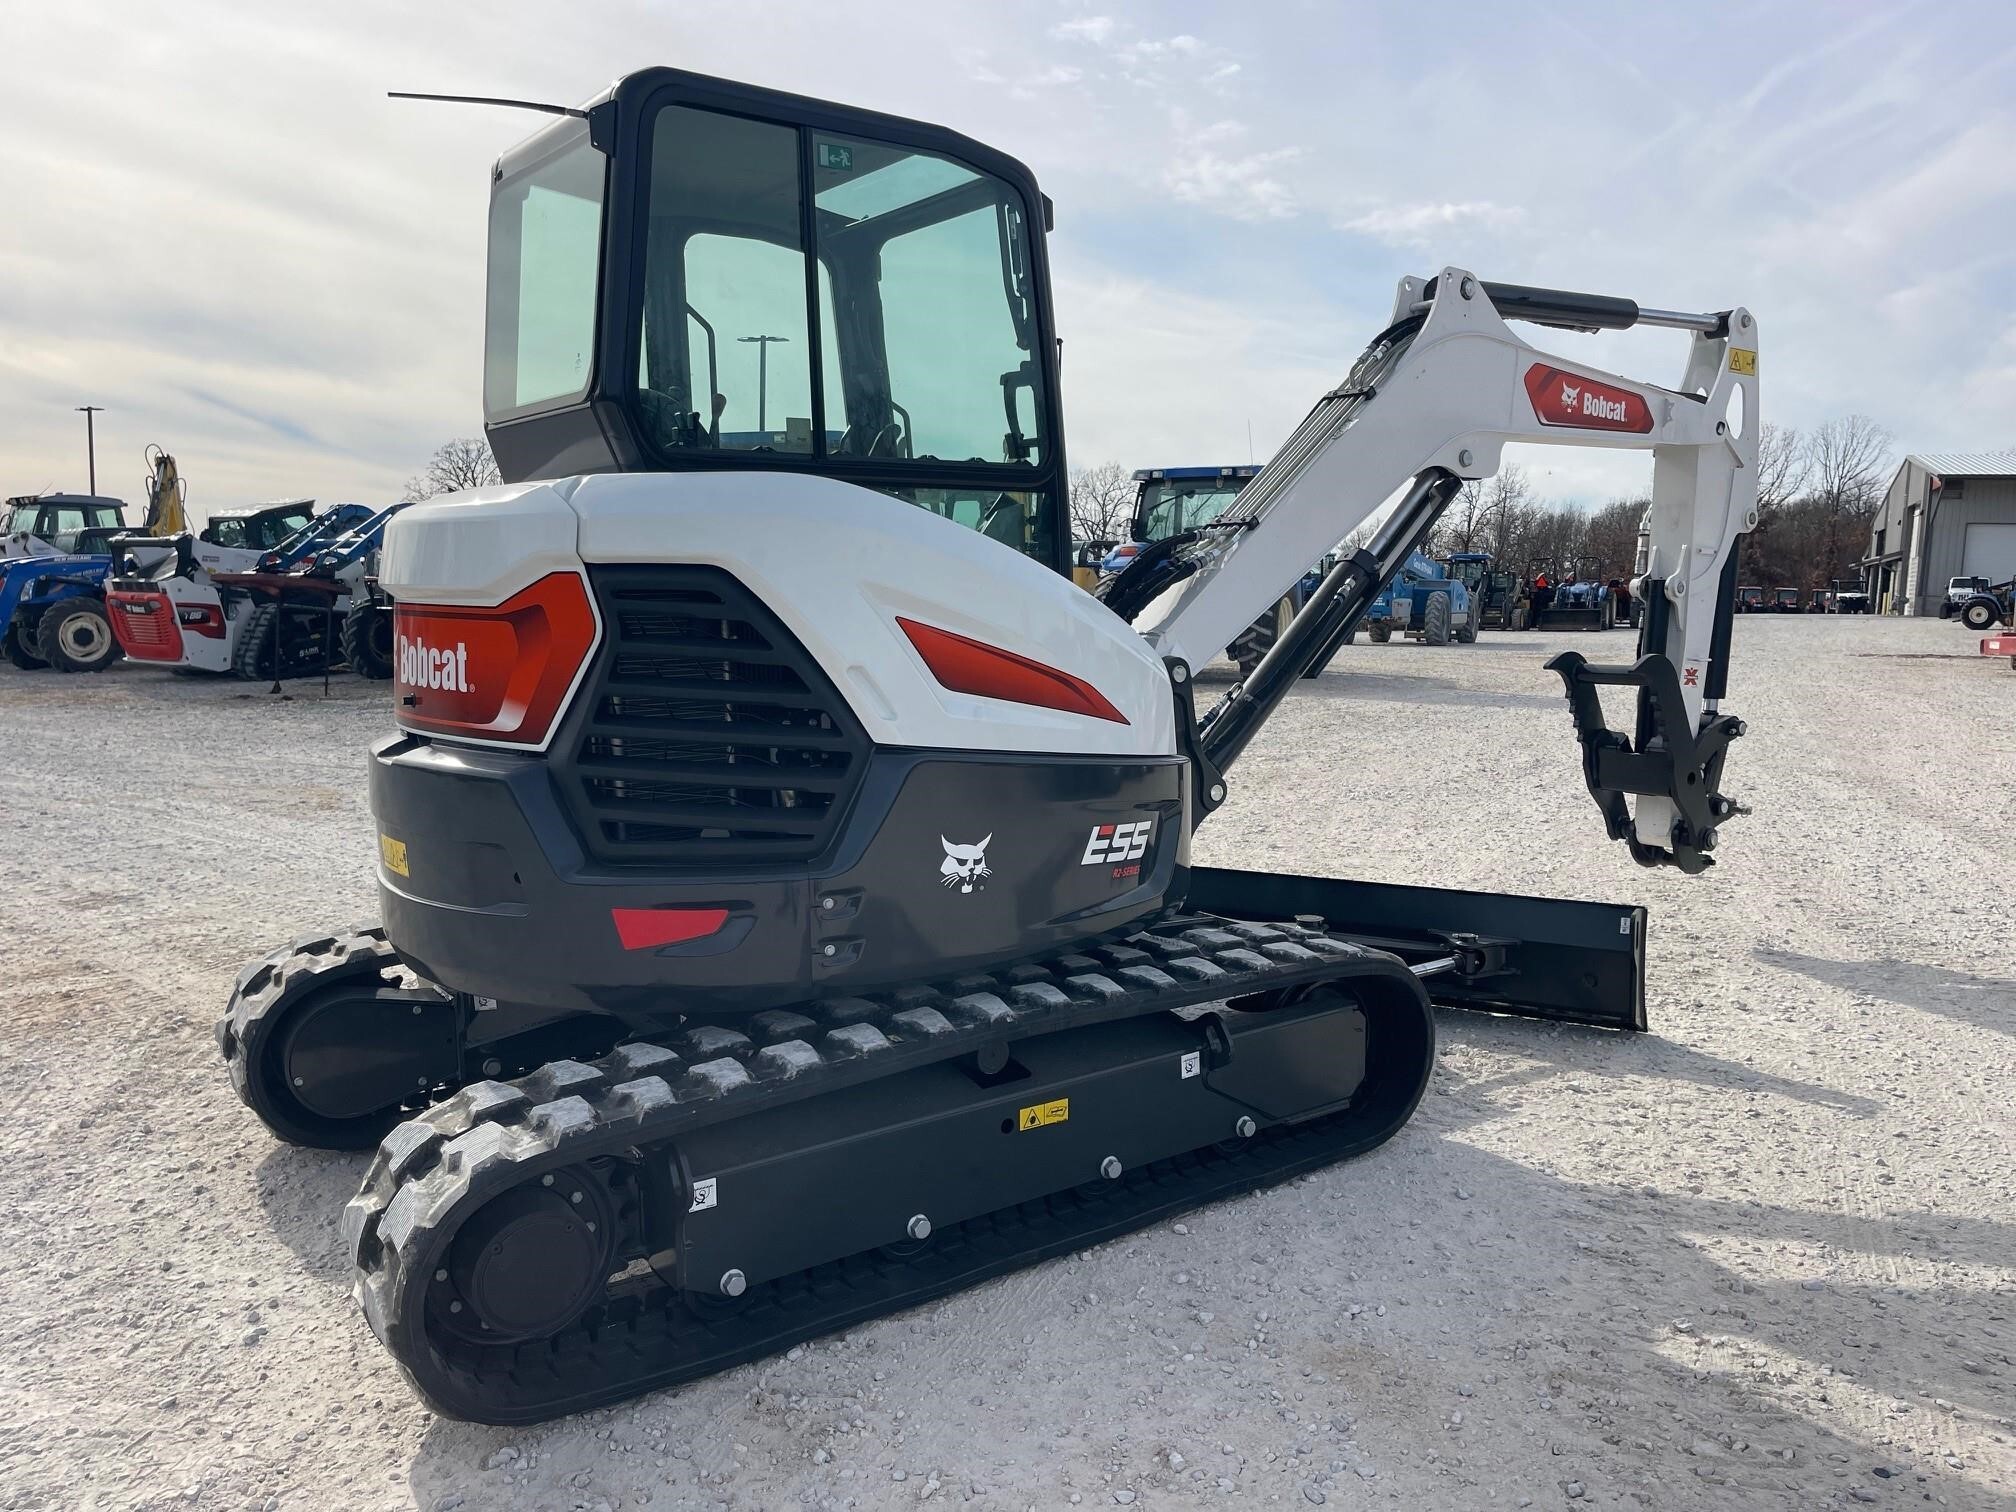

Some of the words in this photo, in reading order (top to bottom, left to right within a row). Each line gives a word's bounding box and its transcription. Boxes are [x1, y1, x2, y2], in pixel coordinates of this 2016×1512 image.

[1583, 392, 1626, 422] Bobcat
[400, 634, 468, 693] Bobcat
[1080, 821, 1152, 866] E55
